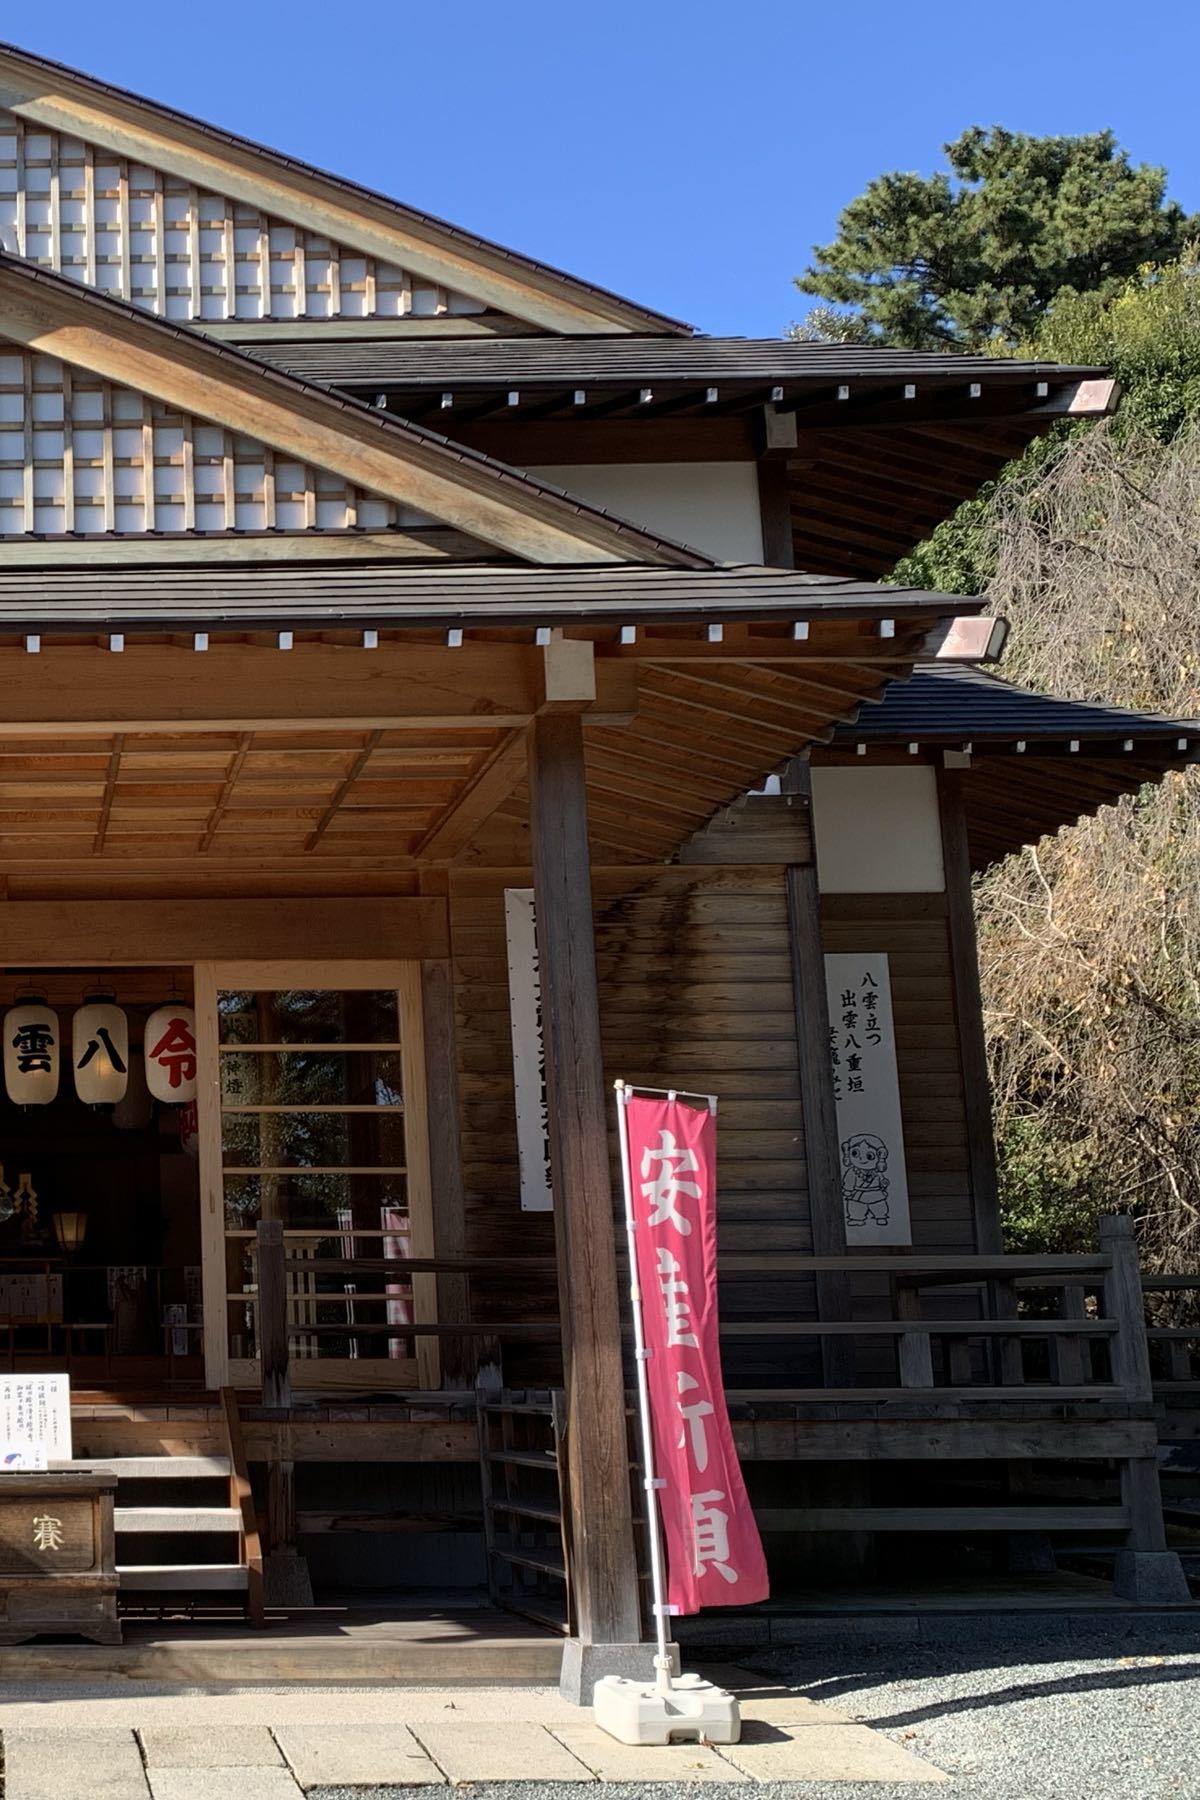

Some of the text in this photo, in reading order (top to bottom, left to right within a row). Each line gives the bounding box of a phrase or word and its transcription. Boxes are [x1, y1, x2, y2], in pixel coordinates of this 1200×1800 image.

[840, 989, 865, 1093] 出雲八重垣
[860, 971, 882, 1047] 八雲立つ
